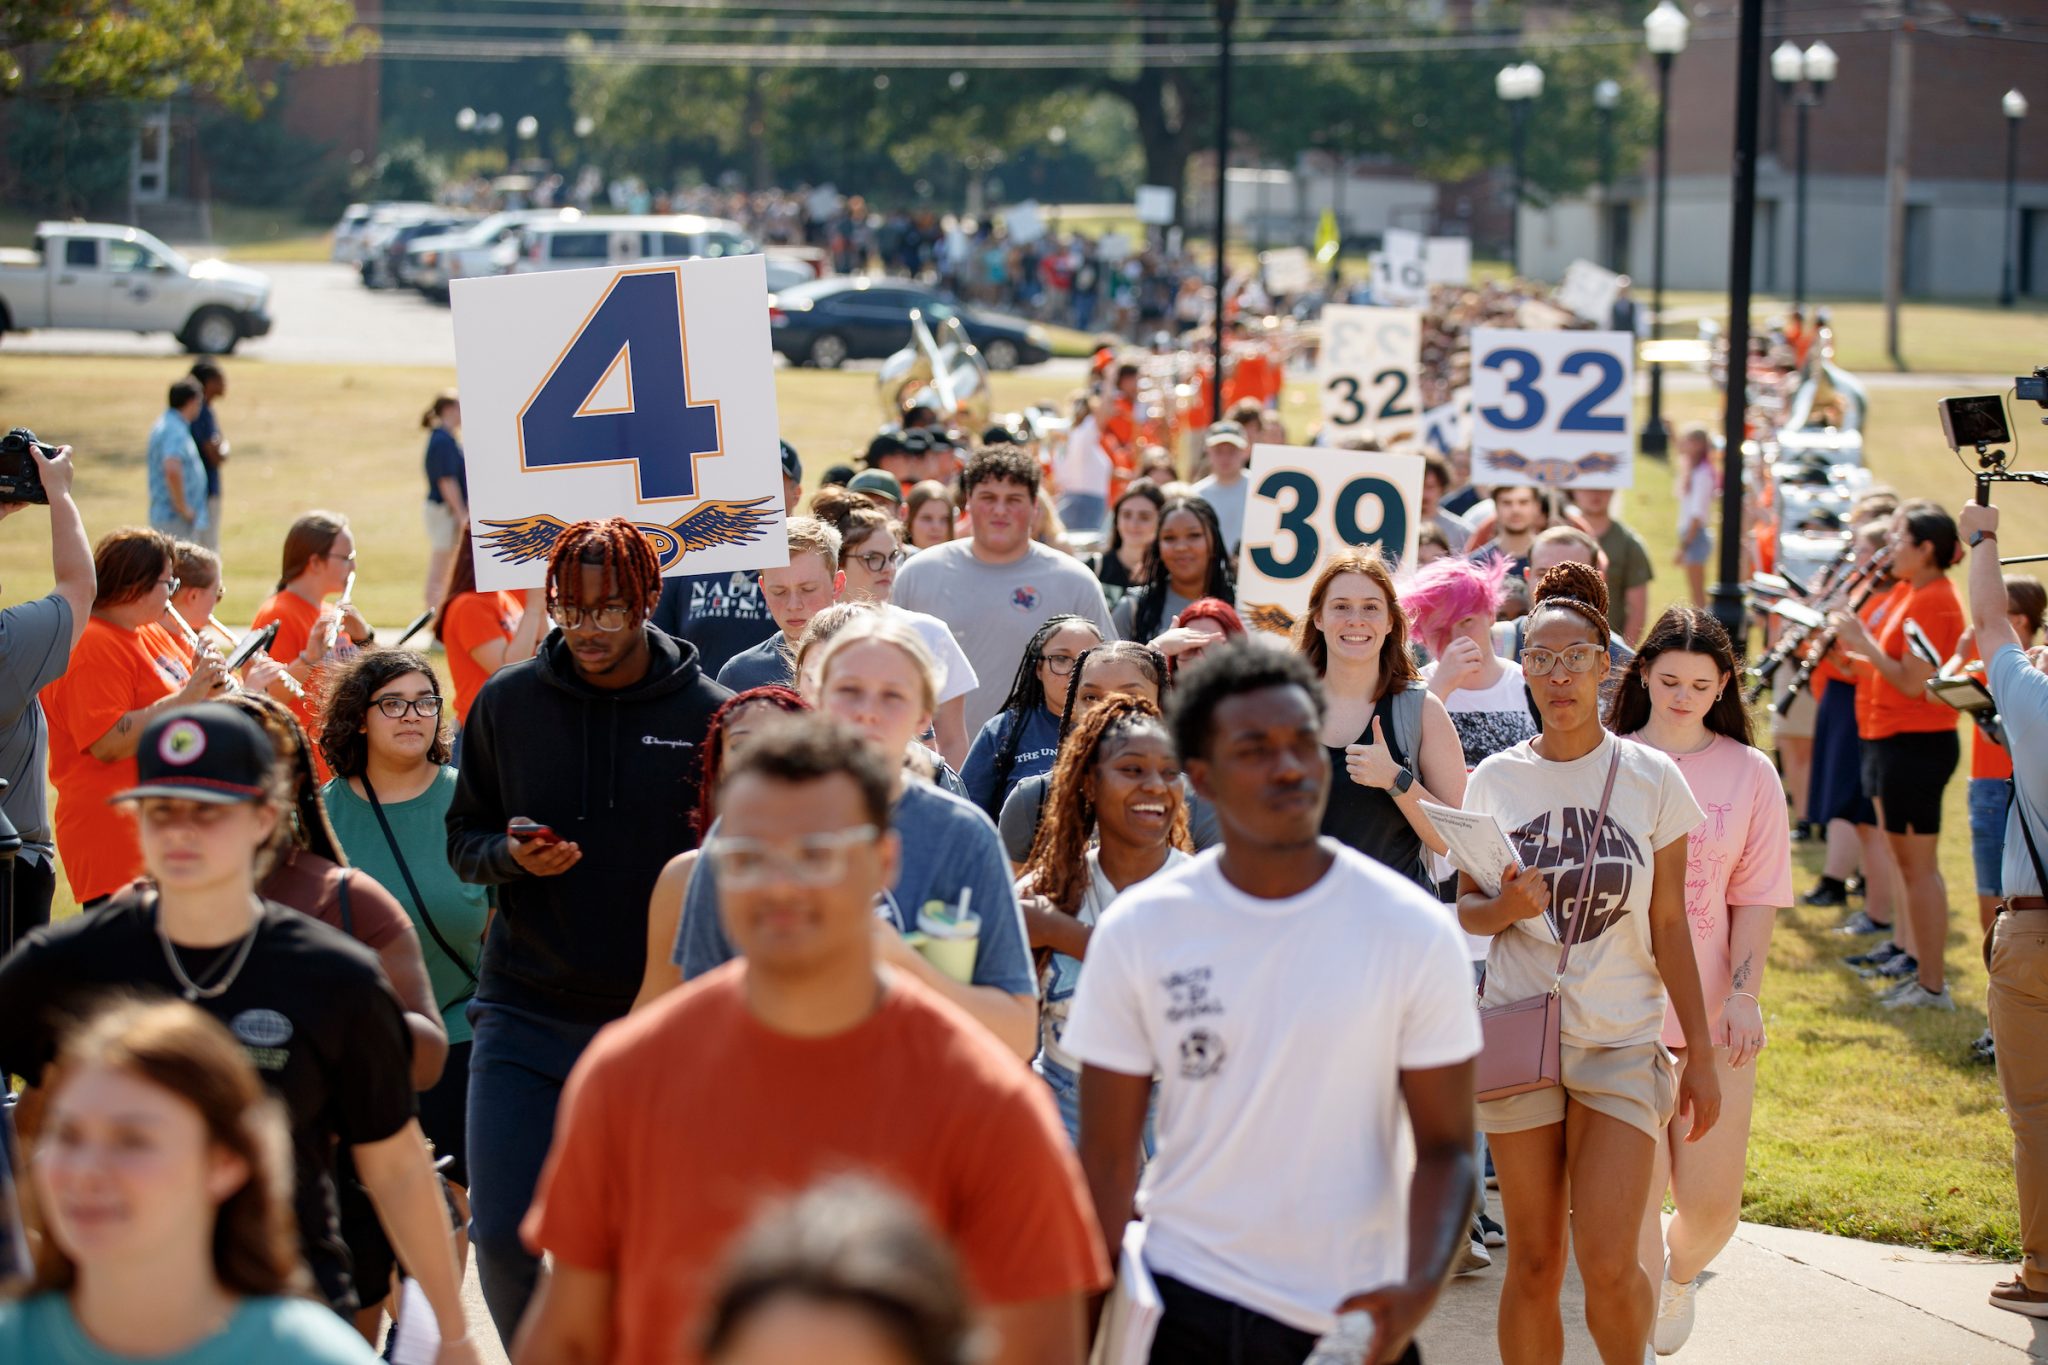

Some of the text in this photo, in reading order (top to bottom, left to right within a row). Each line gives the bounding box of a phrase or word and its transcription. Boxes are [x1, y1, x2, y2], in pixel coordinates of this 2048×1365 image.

[517, 265, 725, 504] 4
[1326, 369, 1415, 427] 32
[1478, 346, 1628, 435] 32
[1249, 470, 1408, 581] 39
[735, 609, 761, 620] SAIL
[641, 735, 695, 749] Champion
[1014, 750, 1040, 763] THE
[1543, 862, 1632, 945] GEL
